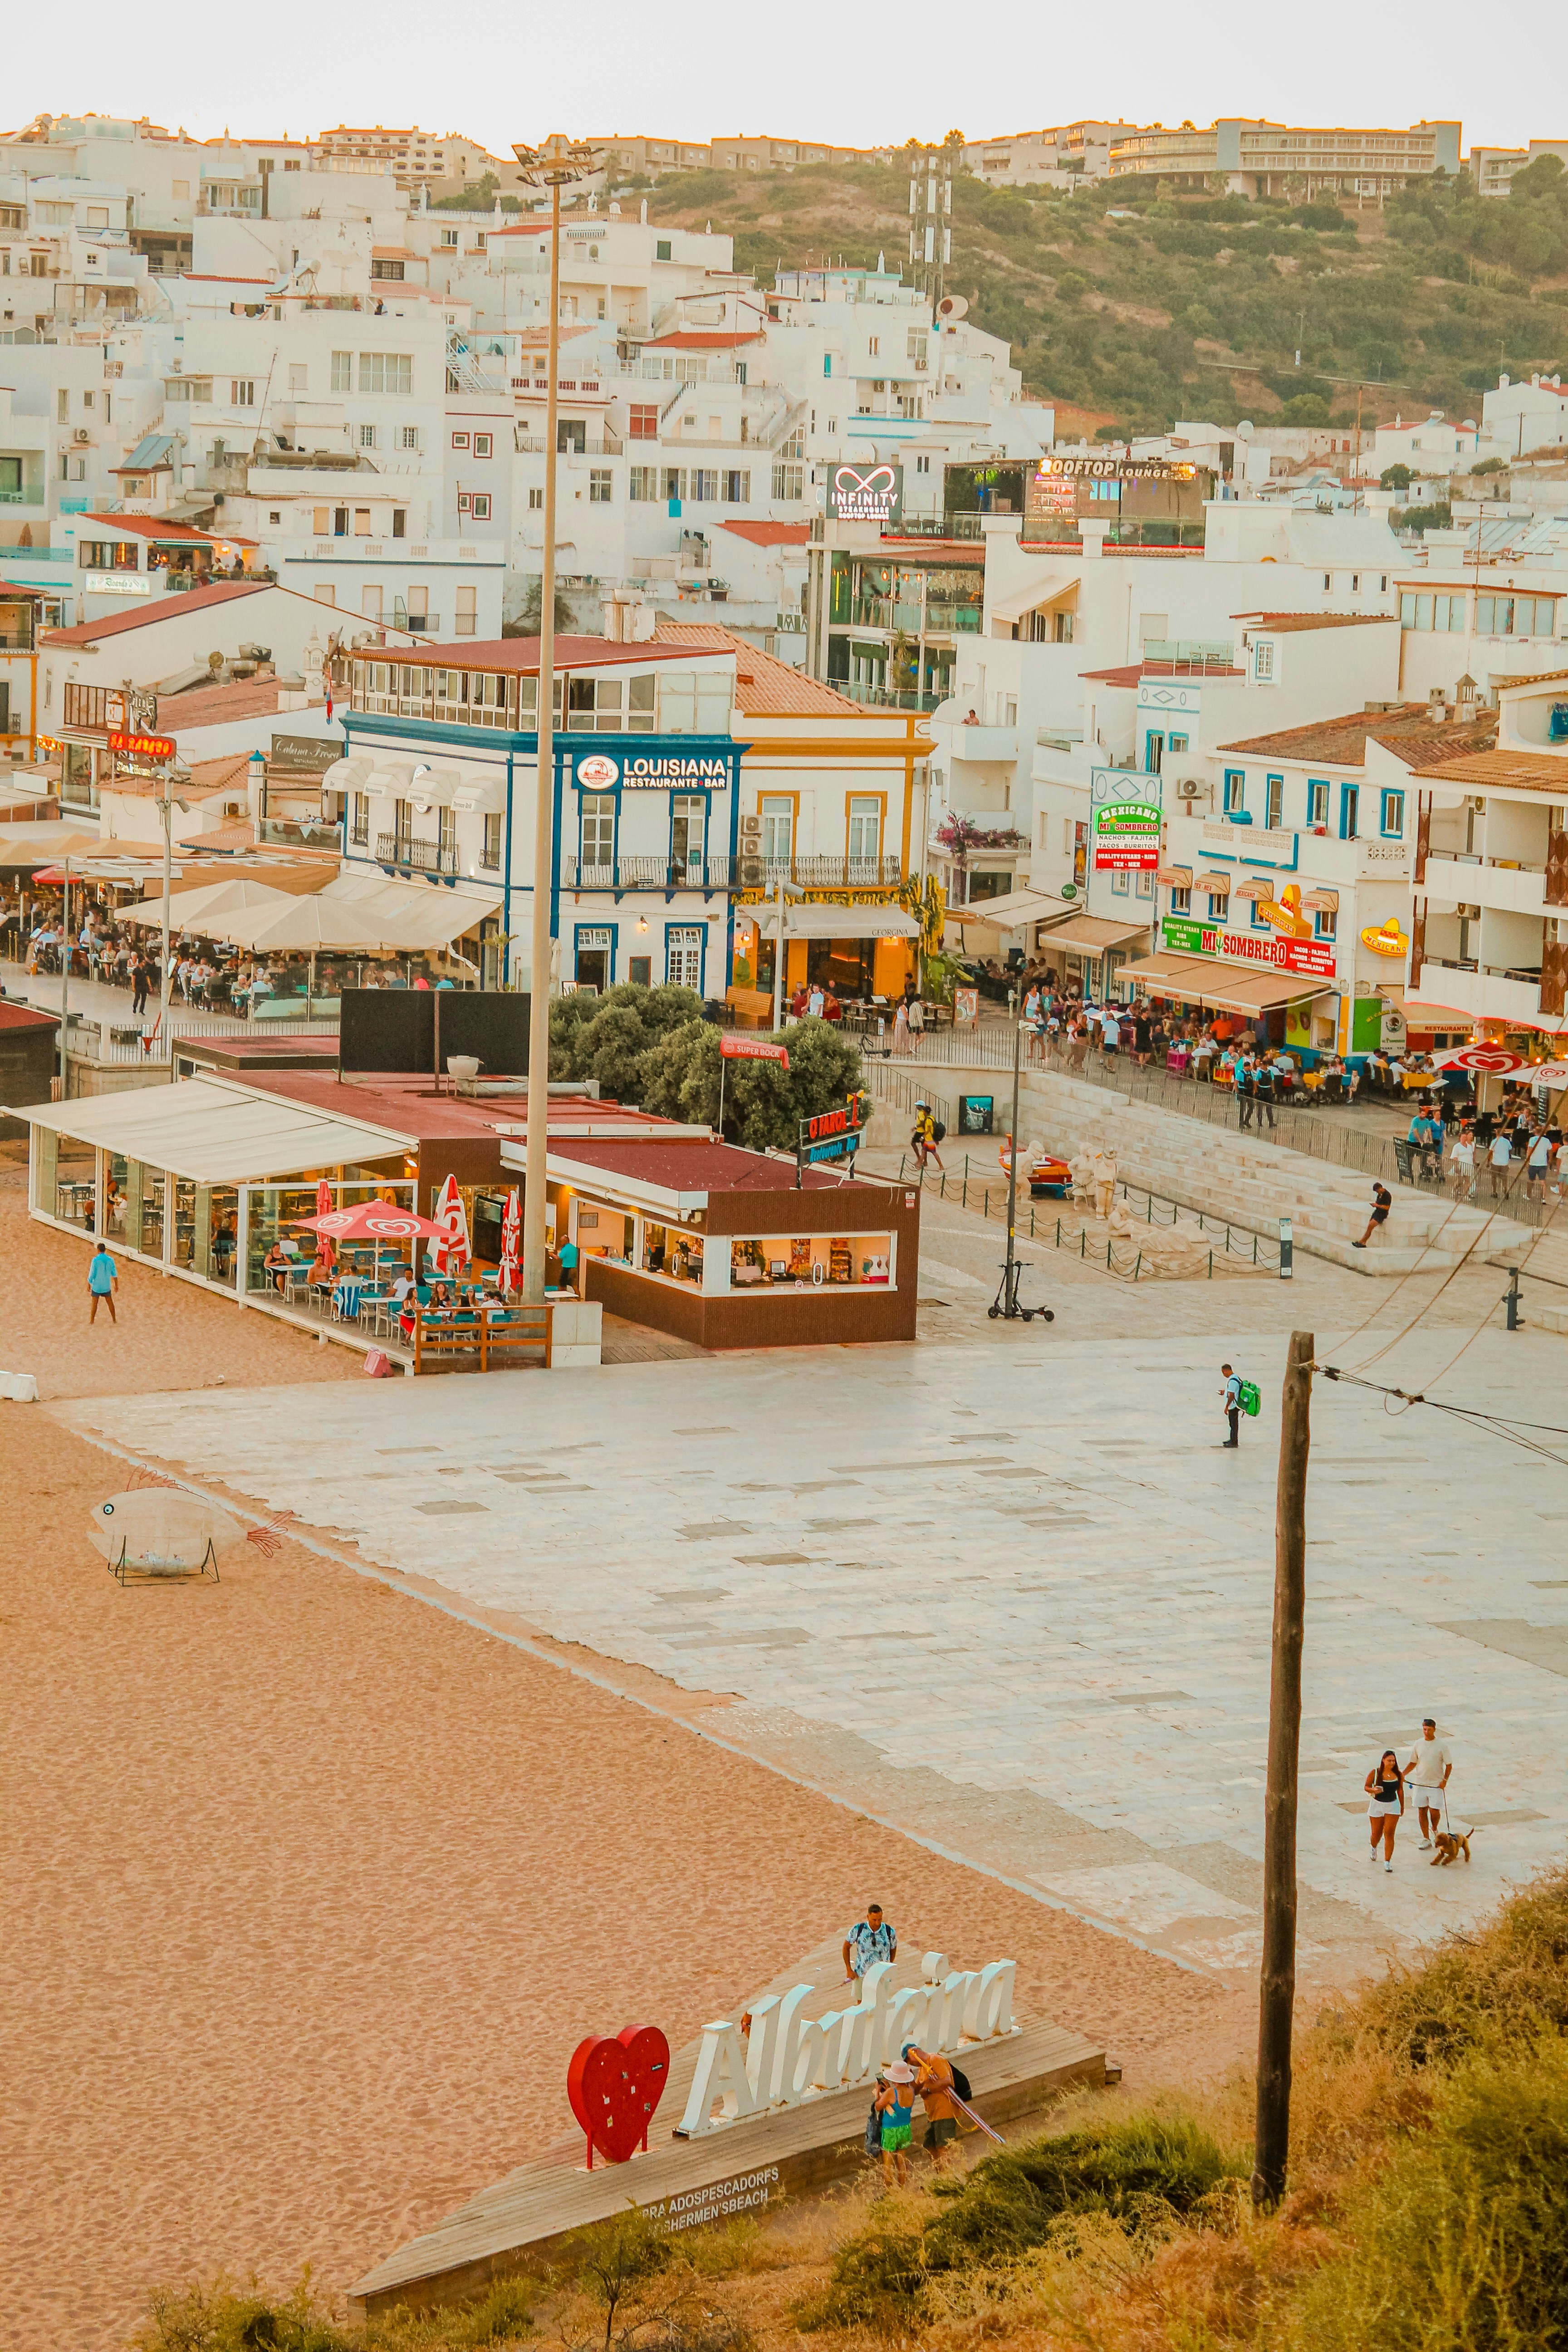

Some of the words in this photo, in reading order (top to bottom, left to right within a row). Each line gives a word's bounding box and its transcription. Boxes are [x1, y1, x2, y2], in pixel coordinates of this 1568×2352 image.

[1119, 467, 1169, 479] LOUNGE
[831, 491, 899, 507] INFINITY
[623, 758, 726, 776] LOUISIANA
[622, 777, 699, 788] RESTAURANTE
[704, 778, 725, 788] BAR
[1101, 806, 1158, 821] MEXICANO
[1115, 823, 1158, 831] SOMBRERO
[1164, 922, 1182, 931] QUALITY
[1183, 925, 1200, 933] STEAKS
[1201, 929, 1217, 953] MI
[1223, 933, 1287, 965] SOMBRERO
[1366, 935, 1406, 952] MEXICANO
[1294, 946, 1308, 954] TACOS
[1311, 949, 1329, 957] FAJITAS
[1289, 953, 1308, 961] NACHOS
[1311, 956, 1333, 966] BURRITOS
[1297, 961, 1325, 972] ENCHILADAS
[736, 1045, 759, 1055] SUPER
[760, 1048, 779, 1058] BOCK
[819, 1110, 847, 1137] FAROL
[678, 1950, 1019, 2132] Albufeira
